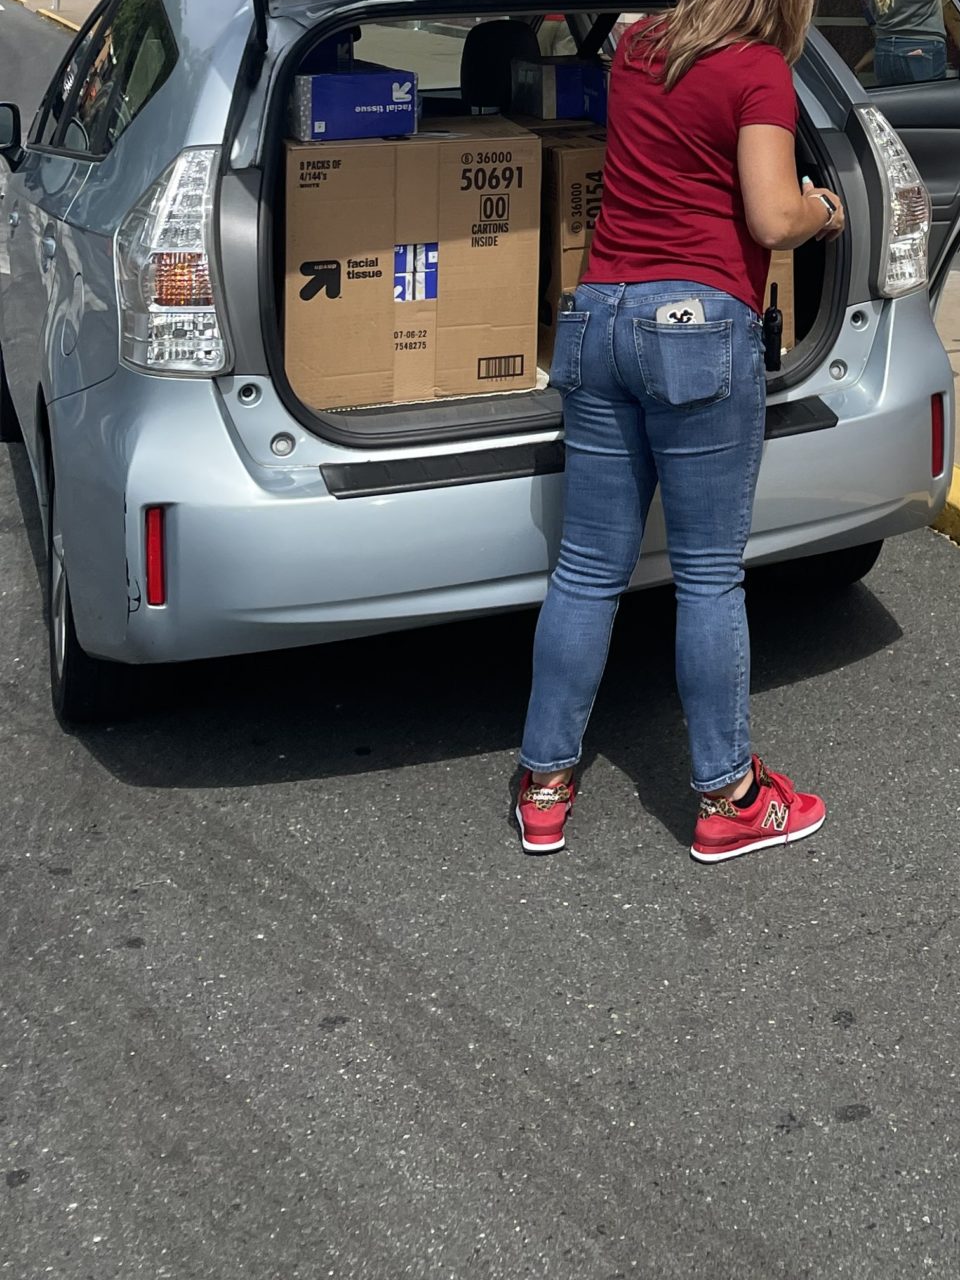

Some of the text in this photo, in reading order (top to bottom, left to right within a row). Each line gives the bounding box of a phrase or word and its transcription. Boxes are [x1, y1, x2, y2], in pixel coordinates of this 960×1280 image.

[354, 104, 412, 113] facial tissue
[476, 151, 512, 164] 36000
[306, 160, 331, 170] PACKS
[332, 159, 342, 169] OF
[460, 166, 523, 191] 50691
[571, 182, 582, 217] 36000
[483, 196, 506, 219] 00
[471, 222, 509, 235] CARTONS
[471, 236, 498, 248] INSIDE
[347, 257, 379, 268] facial
[346, 270, 382, 280] tissue
[393, 329, 427, 339] 07-06-22
[394, 341, 427, 351] 7548275
[761, 800, 789, 831] N
